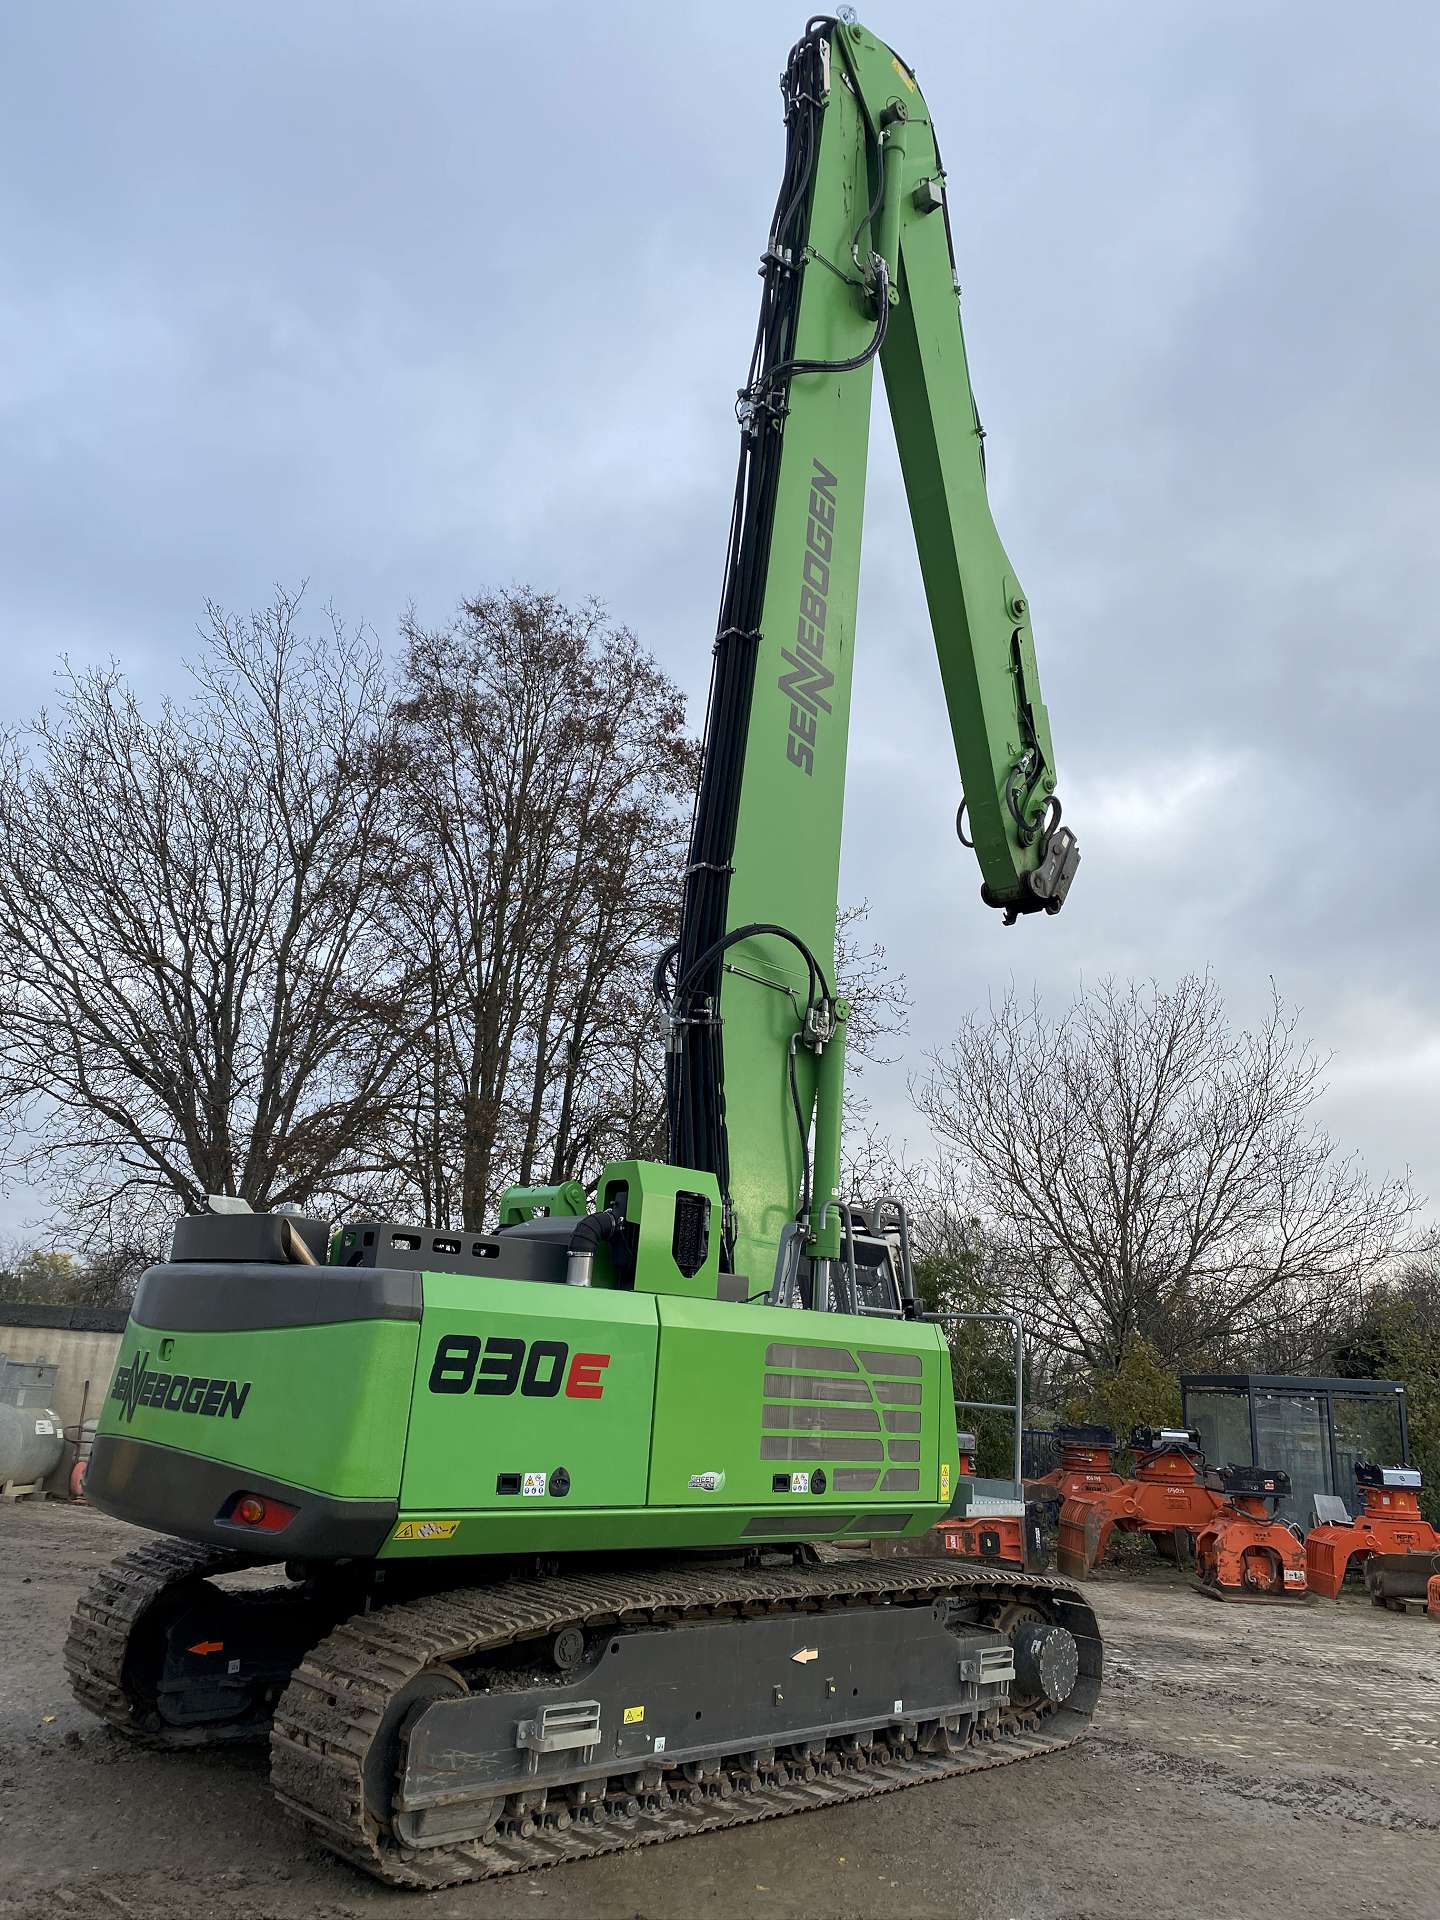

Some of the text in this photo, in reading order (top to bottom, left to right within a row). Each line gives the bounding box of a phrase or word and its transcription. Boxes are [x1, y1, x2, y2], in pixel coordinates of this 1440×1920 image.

[777, 457, 838, 777] SENNEBOGEN
[110, 1350, 252, 1424] SENNEBOGEN
[428, 1334, 611, 1400] 830E
